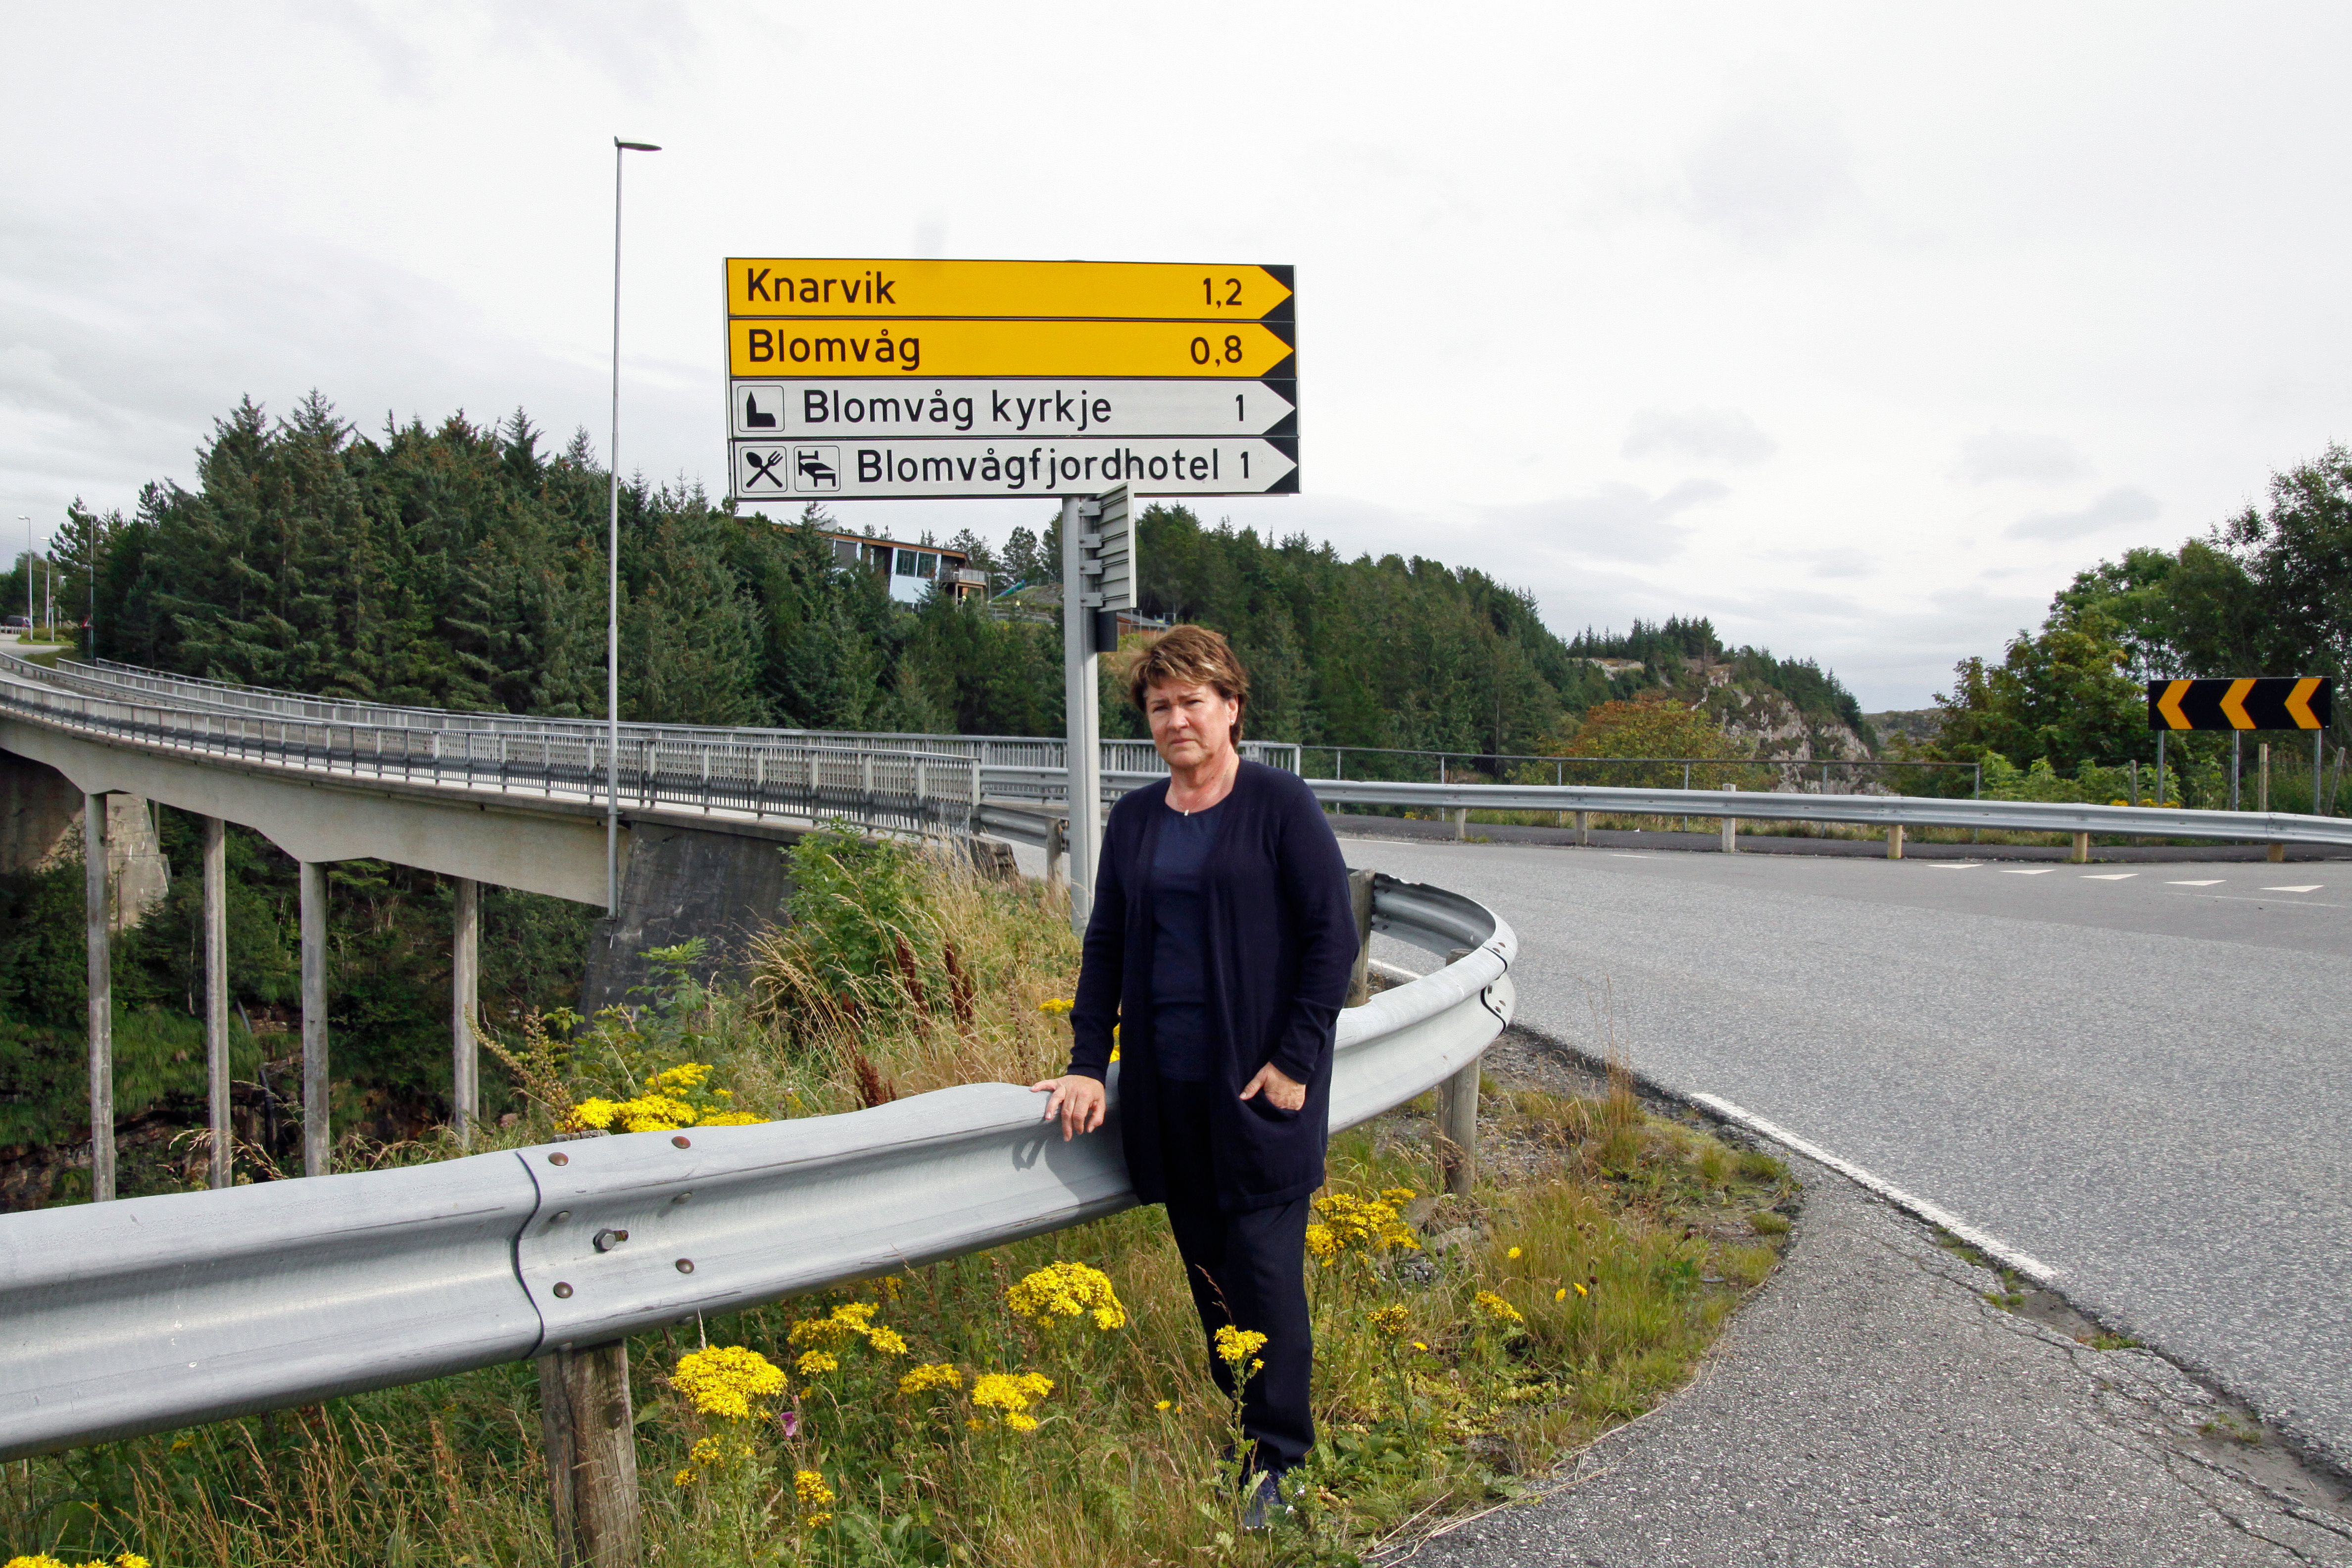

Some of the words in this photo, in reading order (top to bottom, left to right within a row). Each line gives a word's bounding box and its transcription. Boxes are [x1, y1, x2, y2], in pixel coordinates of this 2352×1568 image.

[748, 268, 894, 303] Knarvik
[1203, 278, 1242, 306] 1,2
[749, 329, 920, 371] Blomvåg
[1191, 335, 1242, 364] 0,8
[804, 389, 973, 431] Blomvåg
[992, 390, 1111, 431] kyrkje
[1236, 394, 1244, 421] 1
[858, 447, 1218, 490] Blomvågfjordhotel
[1240, 451, 1249, 479] 1
